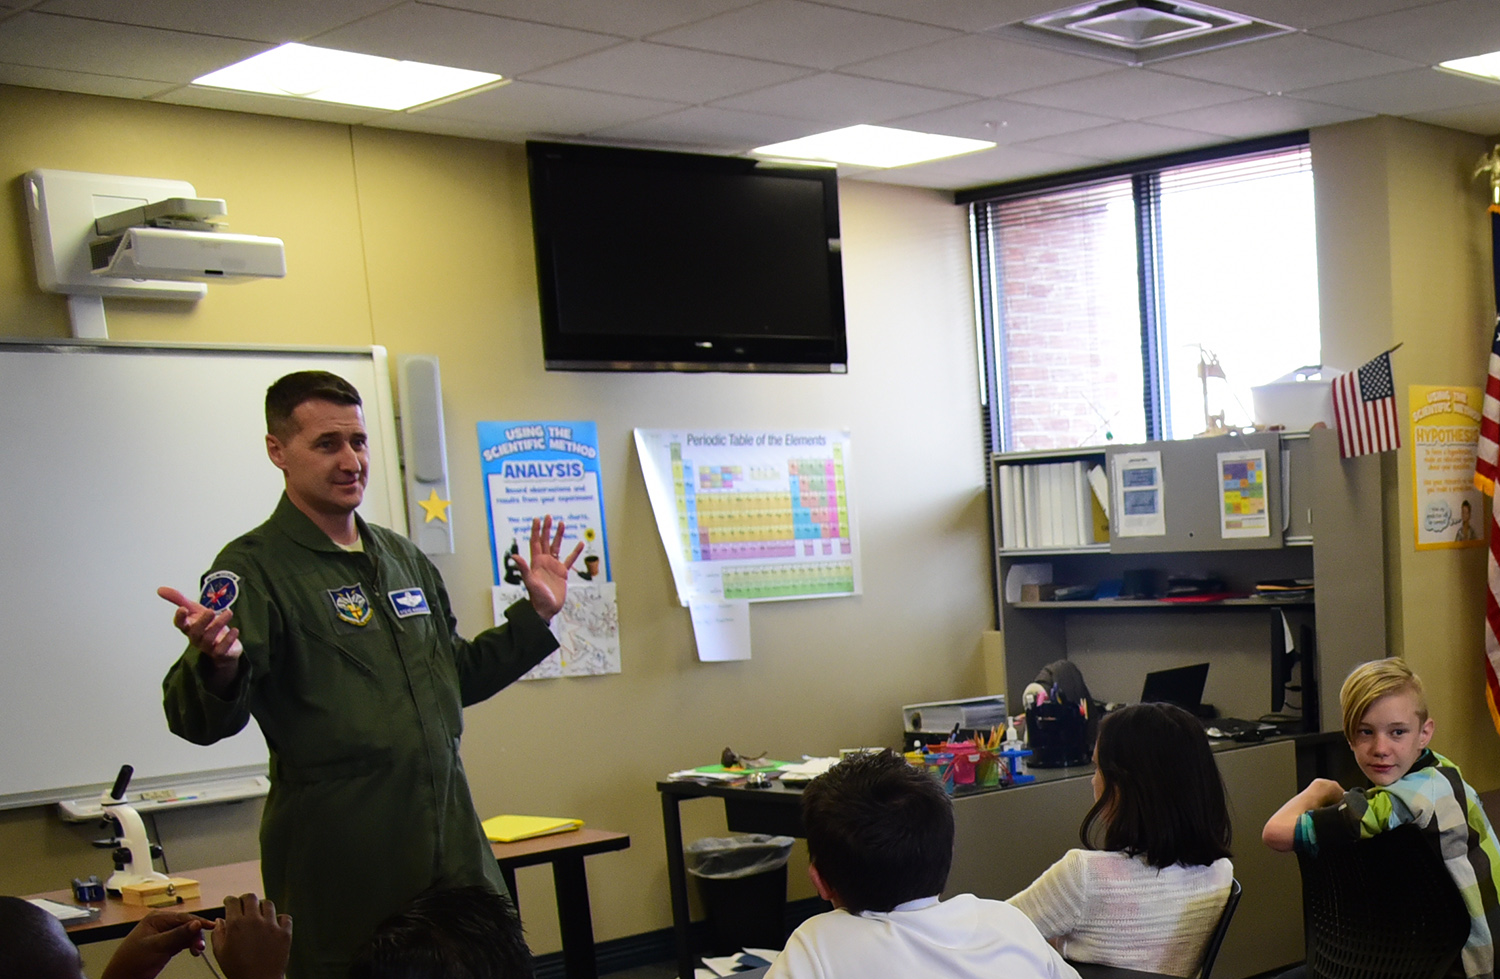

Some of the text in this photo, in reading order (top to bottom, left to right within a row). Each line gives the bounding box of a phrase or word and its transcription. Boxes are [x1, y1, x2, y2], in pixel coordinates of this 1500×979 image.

[505, 425, 572, 440] USING THE
[686, 432, 826, 446] Periodic Table of the Elements
[483, 439, 596, 461] SCIENTIFIC METHOD
[504, 462, 583, 478] ANALYSIS
